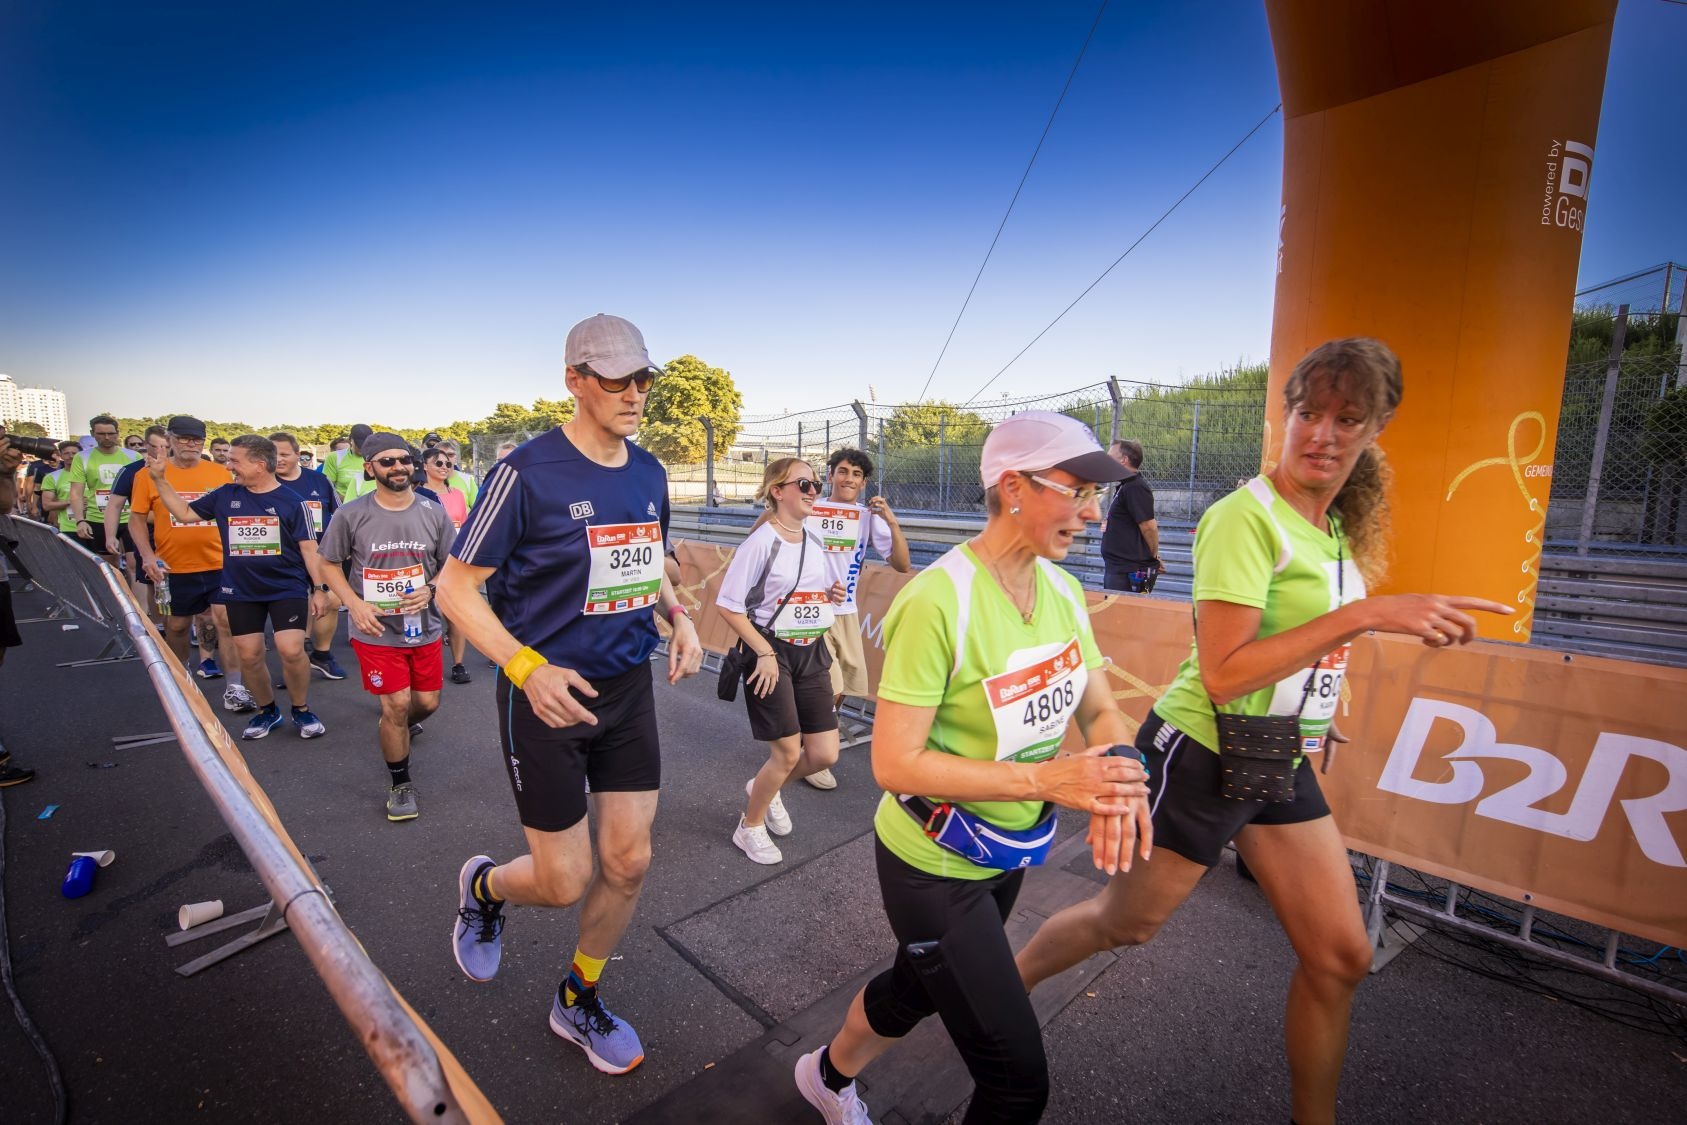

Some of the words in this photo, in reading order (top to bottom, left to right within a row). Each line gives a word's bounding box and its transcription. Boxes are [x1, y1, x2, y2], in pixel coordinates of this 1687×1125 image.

[1547, 139, 1562, 157] by
[1541, 162, 1557, 225] powered
[572, 503, 591, 517] DB
[821, 518, 844, 531] 816
[237, 527, 267, 537] 3326
[371, 540, 427, 552] Leistritz
[609, 546, 652, 570] 3240
[621, 568, 642, 578] MARTIN
[794, 606, 820, 619] 823
[1023, 679, 1073, 727] 4808
[1039, 715, 1065, 734] SABINE
